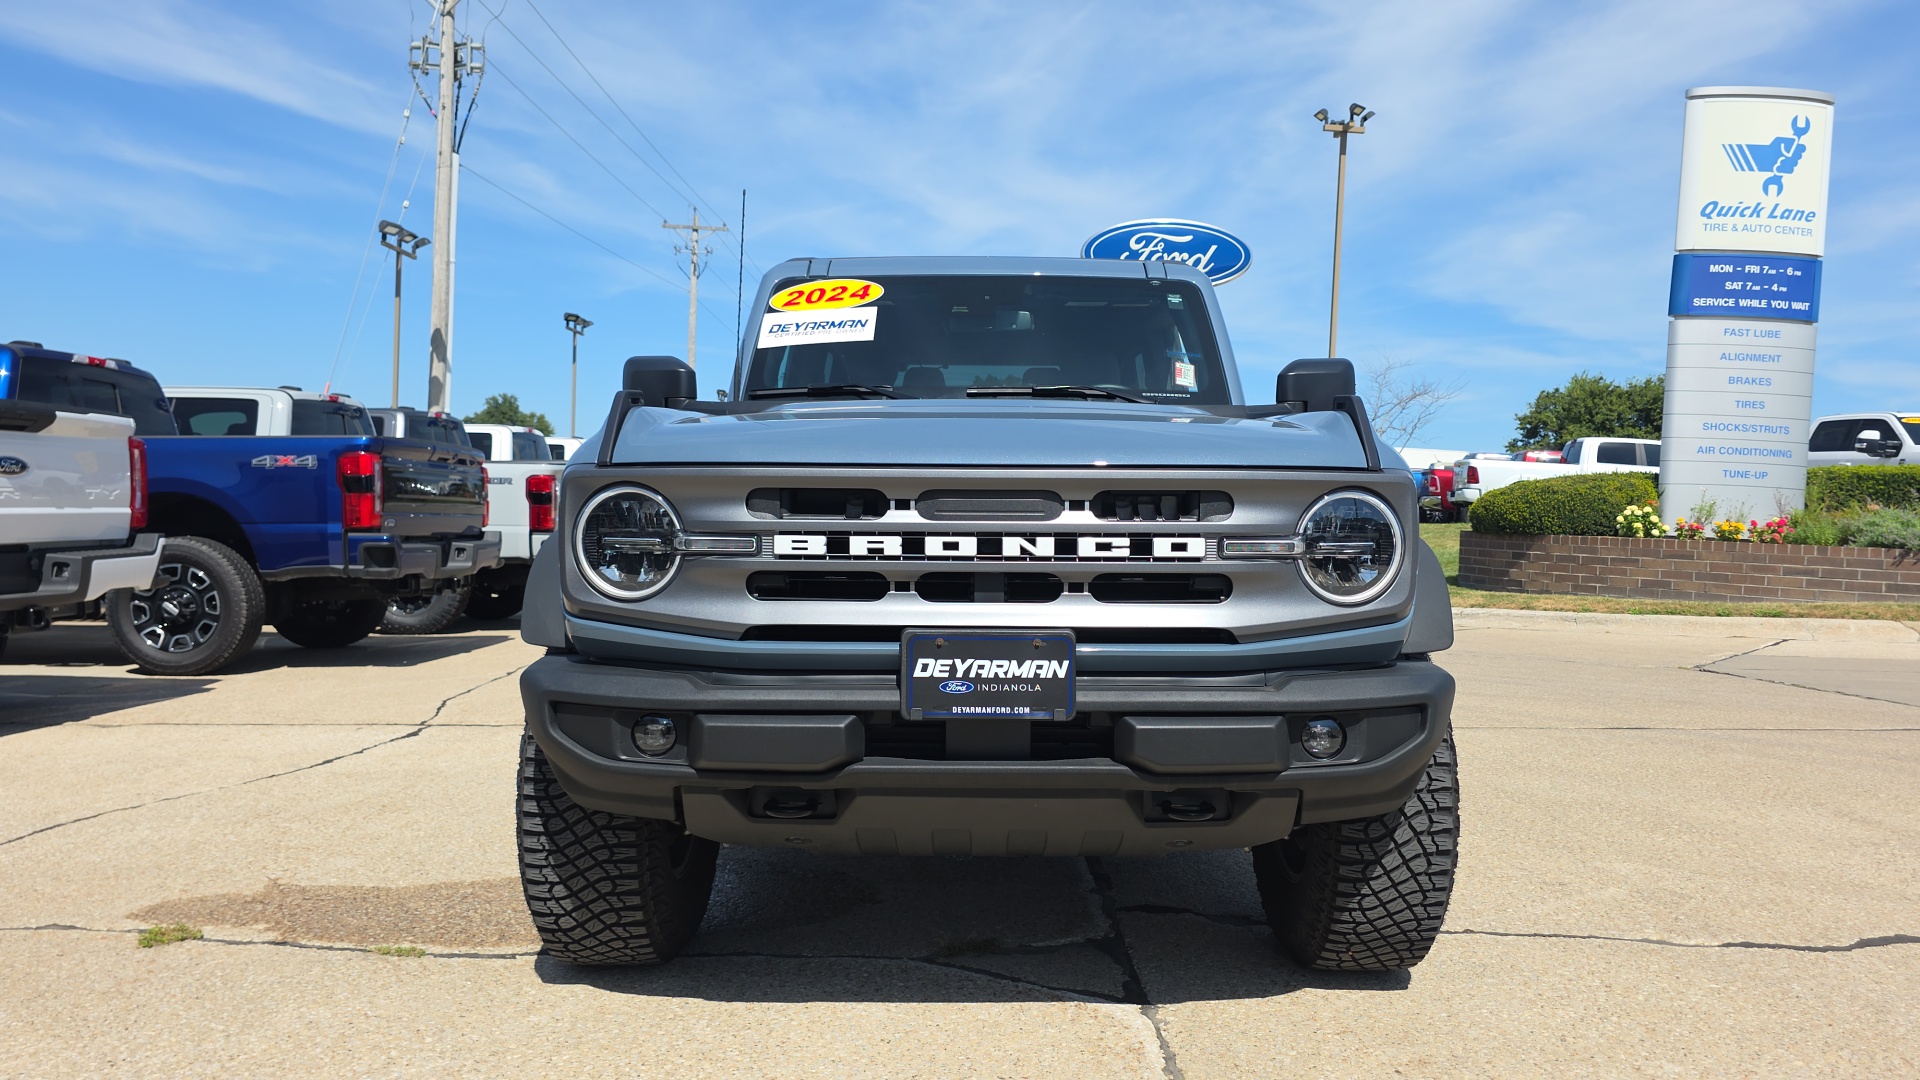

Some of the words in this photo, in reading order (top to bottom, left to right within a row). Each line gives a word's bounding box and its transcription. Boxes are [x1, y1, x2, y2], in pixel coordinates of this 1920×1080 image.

[1700, 200, 1766, 219] Quick
[1767, 203, 1816, 222] Lane
[1703, 223, 1728, 232] TIRE
[1731, 223, 1738, 232] &
[1742, 224, 1771, 233] AUTO
[1775, 225, 1812, 237] CENTER
[1709, 264, 1733, 273] MON
[1745, 265, 1760, 273] FRI
[1725, 281, 1743, 290] SAT
[782, 285, 871, 308] 2024
[1693, 297, 1735, 307] SERVICE
[1738, 298, 1768, 308] WHILE
[1770, 300, 1788, 309] YOU
[1791, 301, 1810, 310] WAIT
[769, 319, 869, 334] DEYARMAN
[1724, 328, 1751, 337] FAST
[1753, 329, 1781, 339] LUBE
[1720, 352, 1781, 363] ALIGNMENT
[1728, 376, 1772, 387] BRAKES
[1735, 400, 1765, 410] TIRES
[1702, 422, 1790, 435] SHOCKS/STRUTS
[1697, 446, 1716, 455] AIR
[1719, 447, 1792, 458] CONDITIONING
[1723, 469, 1768, 480] TUNE-UP
[773, 535, 1206, 557] BRONCO
[913, 658, 1069, 679] DEYARMAN
[946, 682, 967, 692] Ford
[978, 683, 1042, 692] INDIANOLA
[952, 706, 1030, 715] DEYARMANFORD.COM
